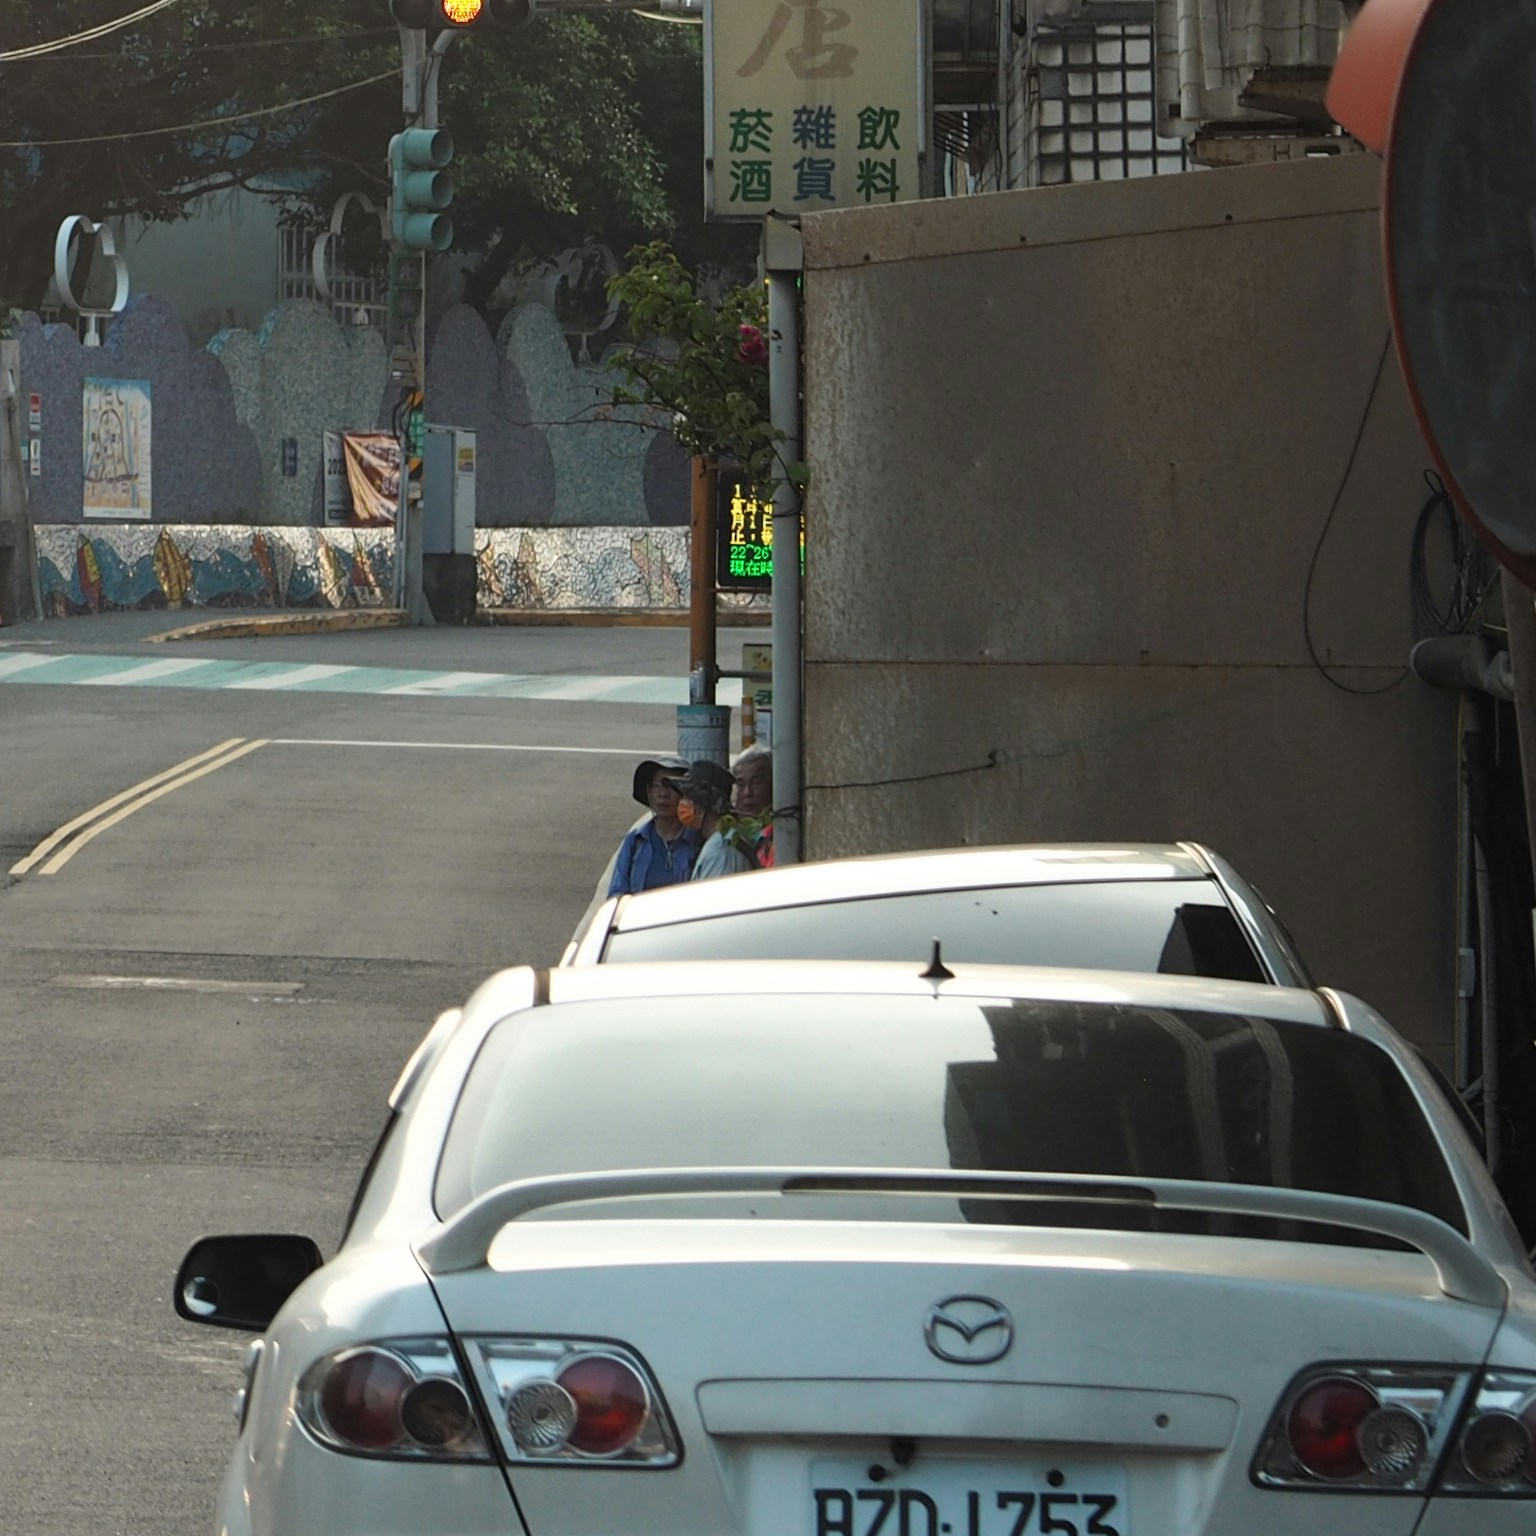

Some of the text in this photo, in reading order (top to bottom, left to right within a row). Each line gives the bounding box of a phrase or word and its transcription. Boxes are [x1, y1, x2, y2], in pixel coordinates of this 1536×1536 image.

[729, 107, 773, 202] 菸酒
[792, 105, 836, 201] 雜貨
[856, 105, 900, 202] 飲料
